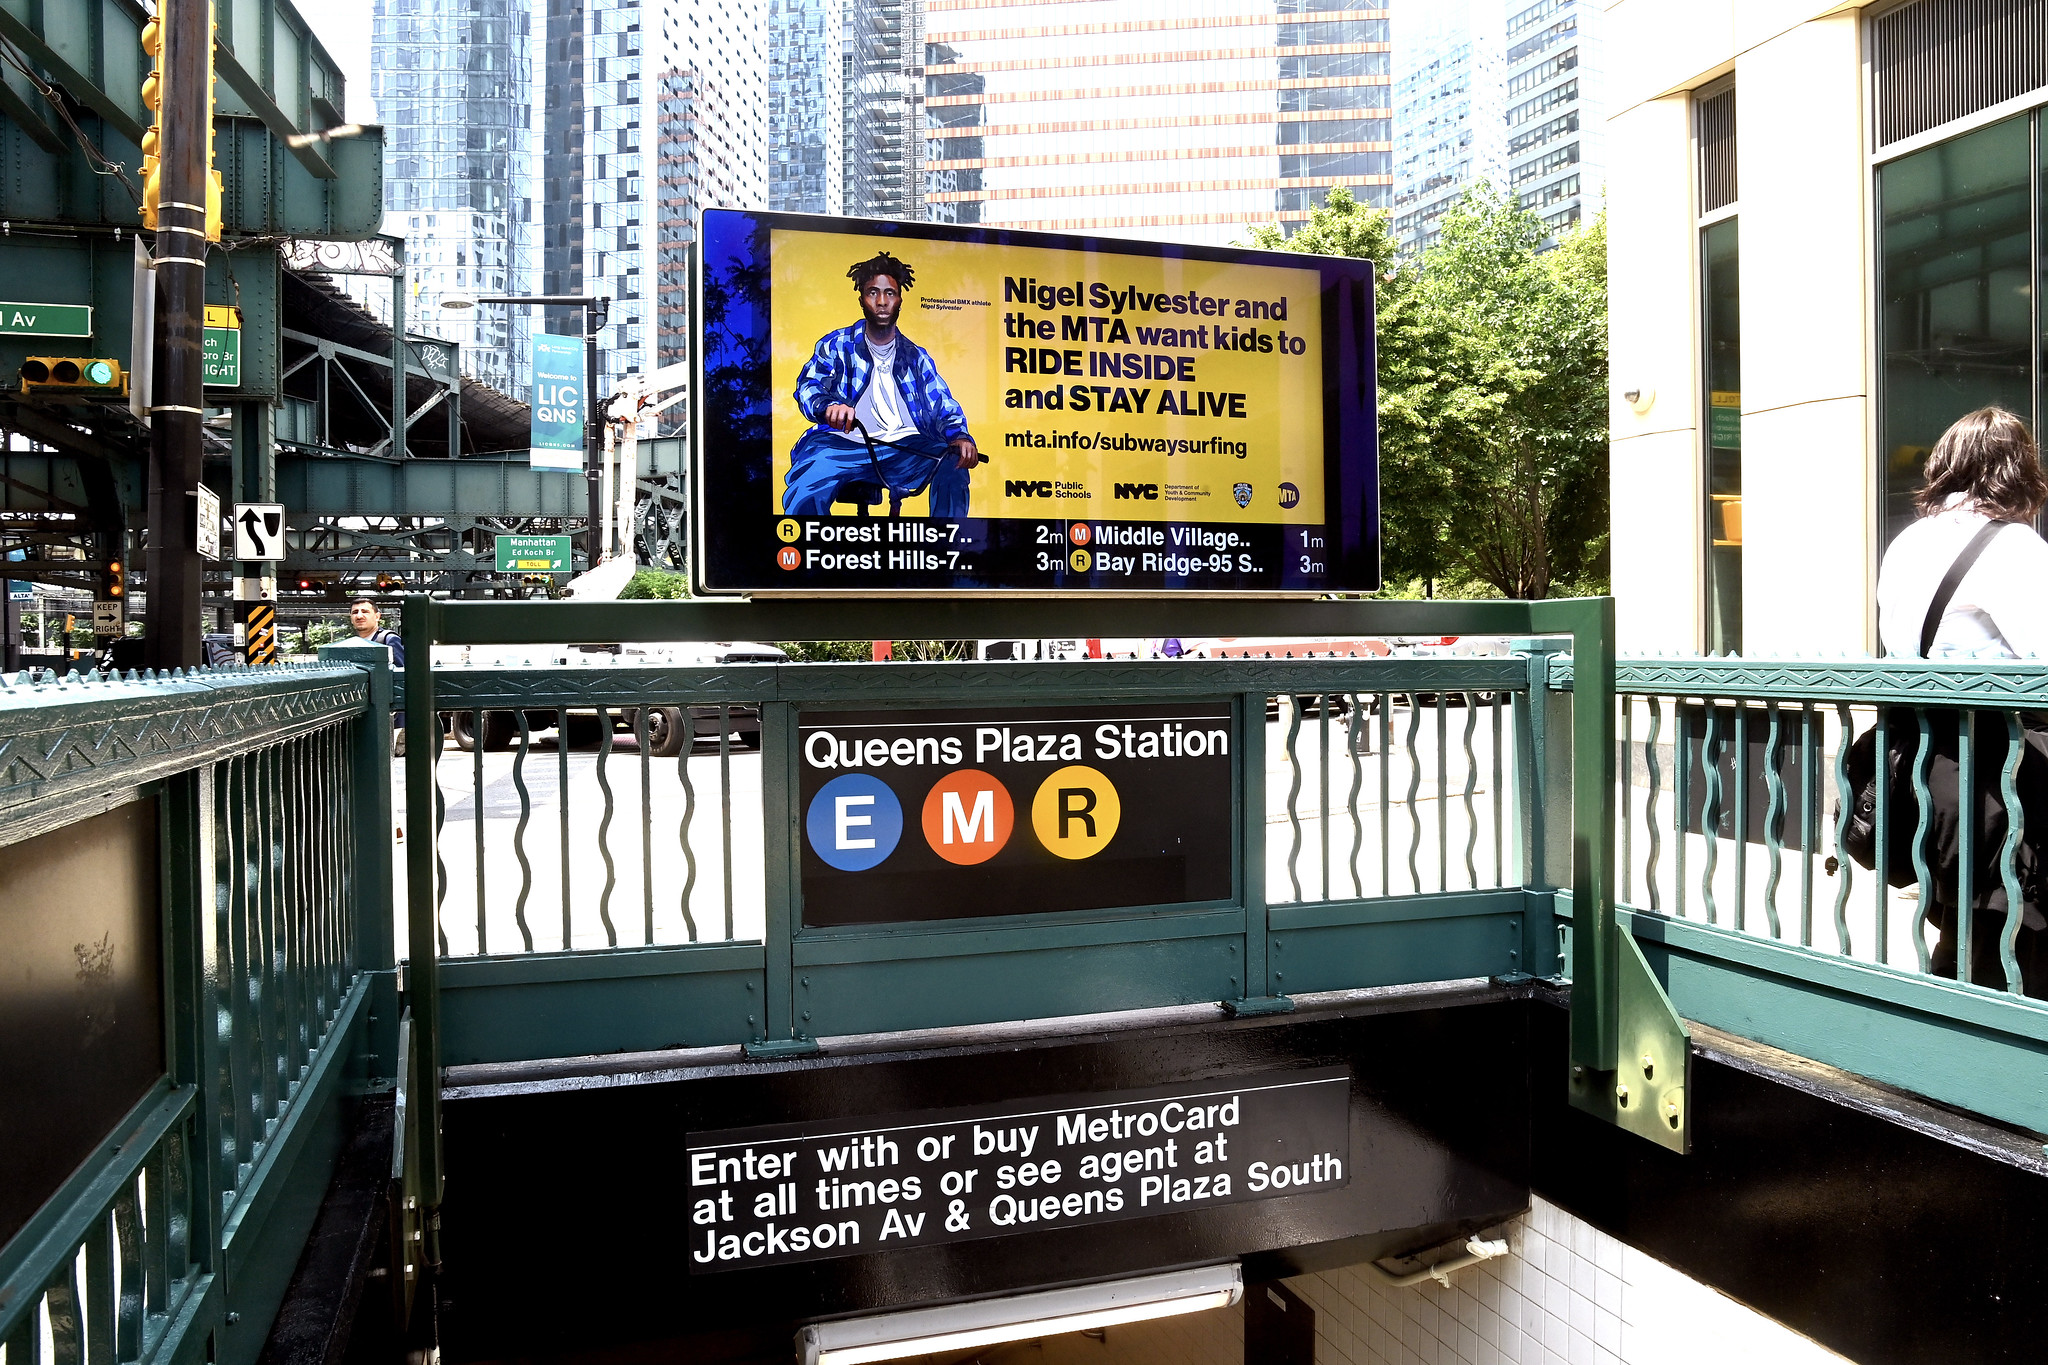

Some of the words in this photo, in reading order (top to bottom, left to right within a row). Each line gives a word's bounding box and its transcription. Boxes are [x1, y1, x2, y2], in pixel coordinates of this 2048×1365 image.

[1004, 276, 1083, 310] Nigel
[1089, 282, 1230, 316] Sylvester
[1234, 297, 1287, 321] and
[11, 311, 36, 327] Av
[1004, 312, 1055, 340] the
[1061, 315, 1131, 344] MTA
[1136, 325, 1209, 349] want
[1214, 325, 1273, 353] kids
[1278, 330, 1307, 355] to
[204, 364, 236, 376] IGHT
[537, 371, 569, 380] Welcome
[1005, 347, 1083, 376] RIDE
[1090, 351, 1196, 382] INSIDE
[538, 383, 579, 407] LIC
[1005, 385, 1064, 411] and
[1069, 385, 1152, 414] STAY
[1156, 389, 1247, 419] ALIVE
[537, 406, 577, 424] QNS
[1005, 430, 1248, 459] mta.info/subwaysurfing
[1005, 480, 1053, 498] NYC
[1055, 481, 1084, 490] Public
[1055, 490, 1092, 499] Schools
[1114, 482, 1159, 500] NYC
[1278, 488, 1297, 503] MTA
[510, 538, 556, 546] Manhattan
[784, 524, 793, 536] R
[806, 521, 881, 543] Forest
[888, 523, 972, 544] Hills-7..
[1036, 525, 1064, 544] 2m
[1074, 529, 1086, 541] M
[1095, 525, 1164, 547] Middle
[1170, 527, 1251, 551] Village..
[1300, 531, 1324, 548] 1m
[783, 552, 795, 565] M
[806, 549, 881, 570] Forest
[888, 550, 973, 570] Hills-7..
[1036, 552, 1064, 571] 3m
[1075, 555, 1085, 567] R
[1095, 552, 1135, 576] Bay
[1143, 553, 1233, 576] Ridge-95
[1238, 555, 1263, 572] S..
[1300, 556, 1324, 573] 3m
[804, 730, 964, 770] Queens
[976, 727, 1083, 764] Plaza
[1094, 723, 1229, 761] Station
[834, 795, 876, 850] E
[941, 790, 994, 845] M
[1057, 787, 1098, 839] R
[691, 1148, 797, 1186] Enter
[817, 1135, 899, 1172] with
[916, 1134, 956, 1162] or
[973, 1125, 1039, 1157] buy
[1056, 1096, 1240, 1147] MetroCard
[692, 1189, 734, 1225] at
[753, 1182, 797, 1218] all
[815, 1177, 922, 1211] times
[940, 1168, 979, 1196] or
[996, 1159, 1062, 1190] see
[1079, 1138, 1178, 1183] agent
[1194, 1132, 1228, 1165] at
[693, 1220, 859, 1263] Jackson
[878, 1208, 926, 1241] Av
[944, 1199, 971, 1233] &
[988, 1186, 1124, 1226] Queens
[1140, 1172, 1232, 1207] Plaza
[1247, 1152, 1342, 1192] South
